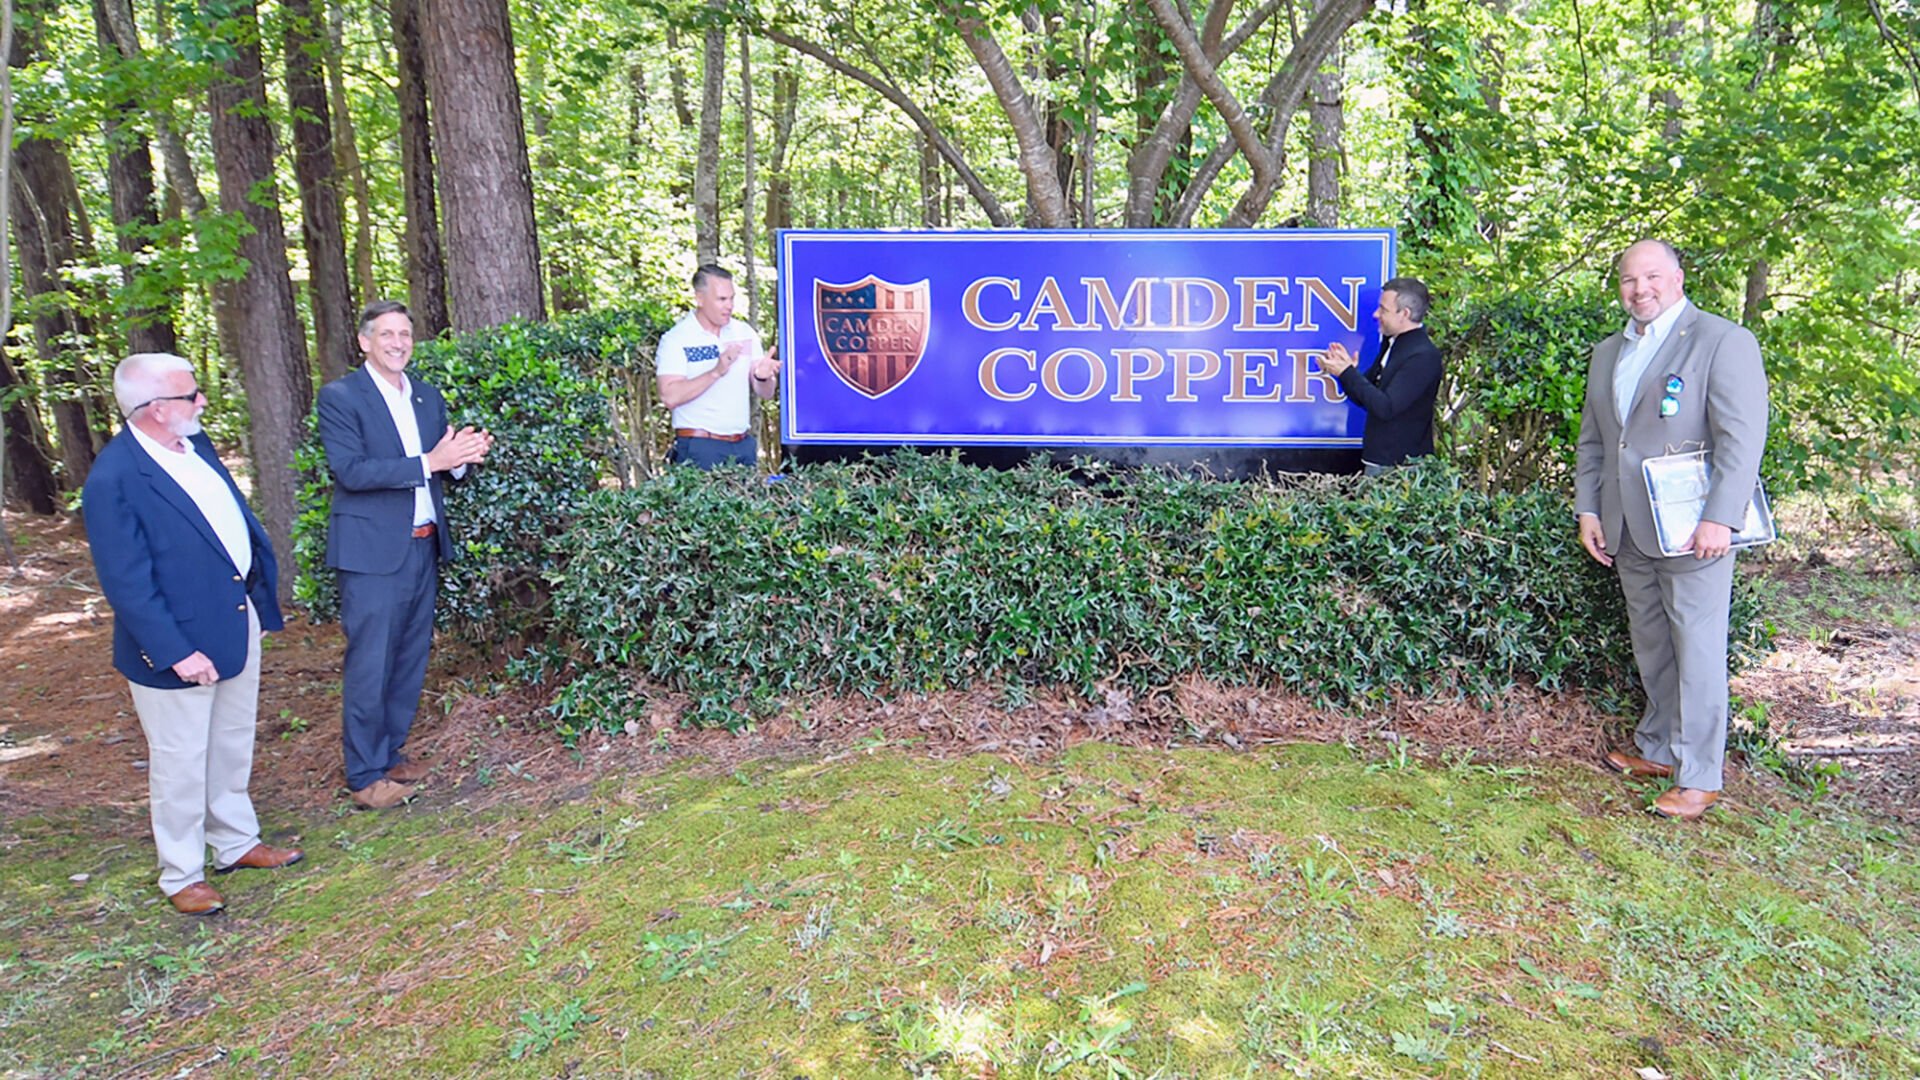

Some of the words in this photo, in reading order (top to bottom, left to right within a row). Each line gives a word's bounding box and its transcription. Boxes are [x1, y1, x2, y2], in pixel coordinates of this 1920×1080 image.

[961, 276, 1366, 332] CAMDEN
[825, 317, 918, 334] CAMDEN
[835, 335, 914, 350] COPPER
[978, 347, 1348, 403] COPPER
